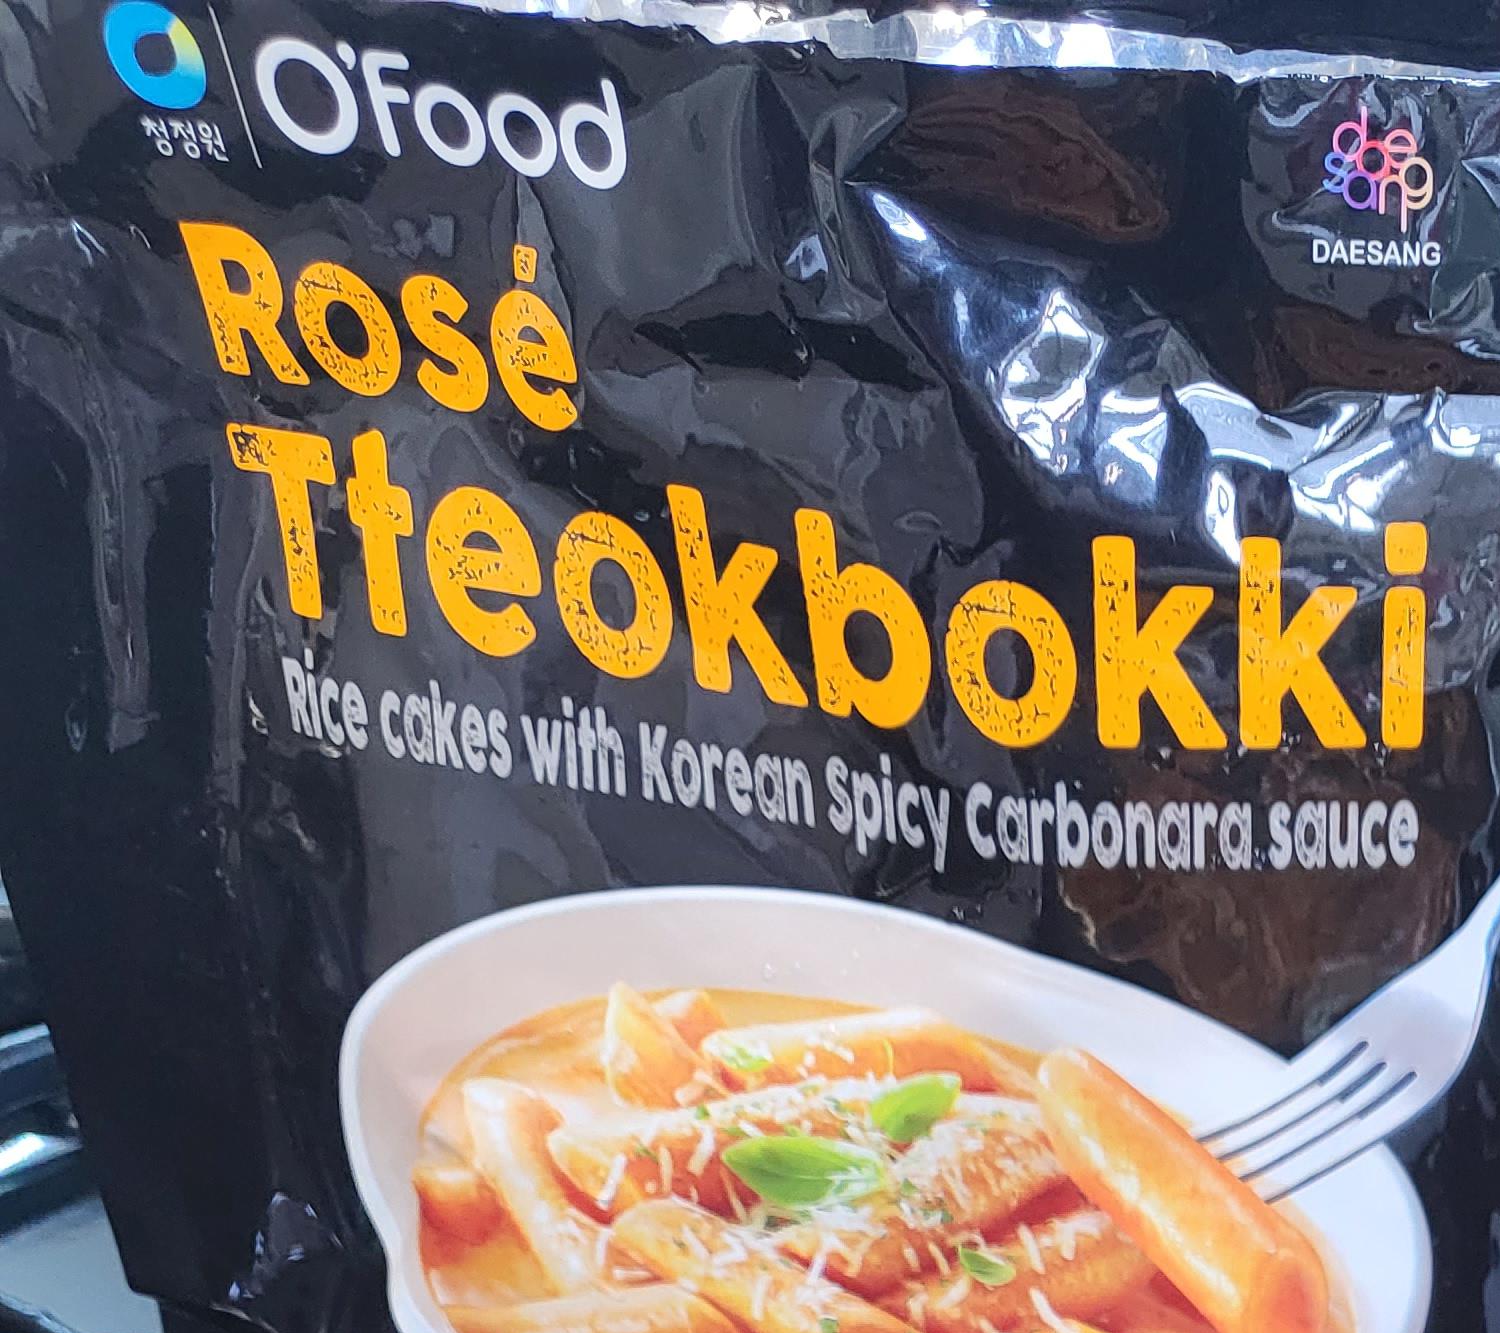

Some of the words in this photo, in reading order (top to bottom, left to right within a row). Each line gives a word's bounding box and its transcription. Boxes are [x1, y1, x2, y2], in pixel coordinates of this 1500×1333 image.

[139, 114, 230, 163] 청정원
[255, 36, 628, 190] O'Food
[179, 219, 579, 432] Rosé
[1312, 238, 1442, 267] DAESANG
[226, 422, 1429, 751] Tteokbokki
[281, 647, 369, 751] Rice
[379, 678, 513, 779] cakes
[520, 695, 628, 798] with
[638, 721, 817, 829] Korean
[1268, 798, 1420, 871] sauce
